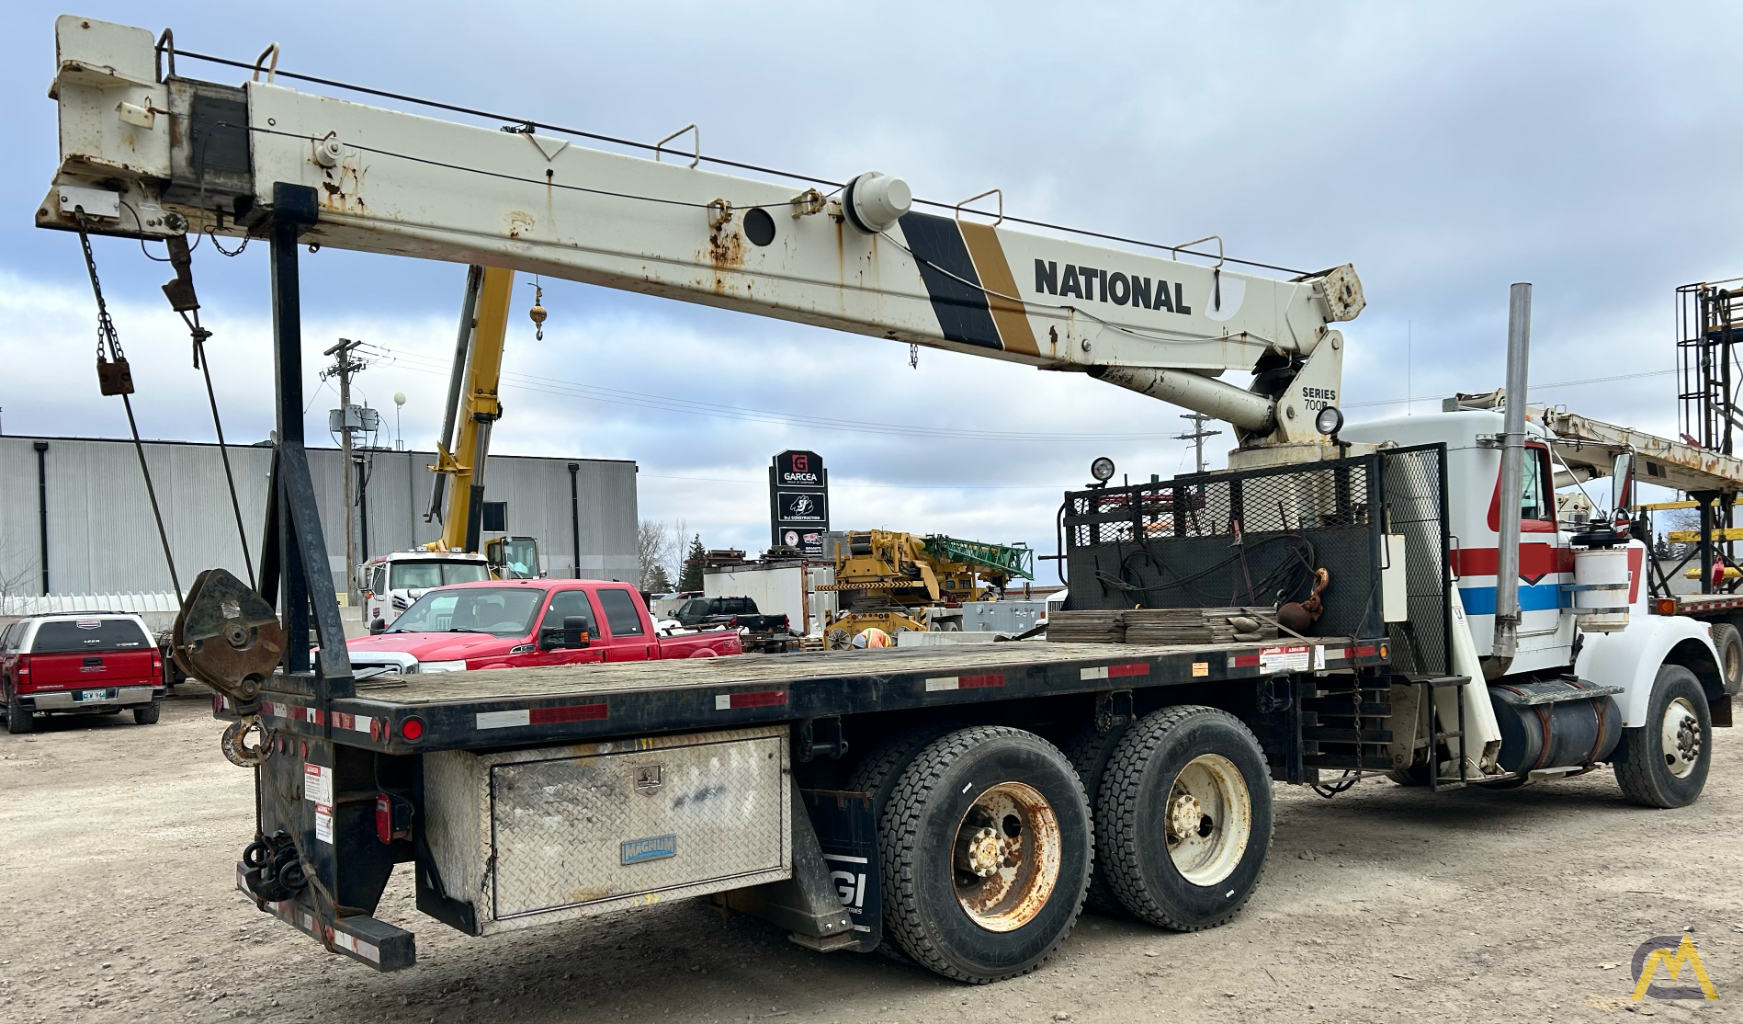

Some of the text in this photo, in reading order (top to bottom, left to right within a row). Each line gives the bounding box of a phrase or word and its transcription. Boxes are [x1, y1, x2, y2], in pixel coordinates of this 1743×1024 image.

[1035, 258, 1192, 316] NATIONAL
[1302, 386, 1336, 401] SERIES
[784, 473, 817, 481] GARCEA
[625, 836, 675, 860] MAGNUM
